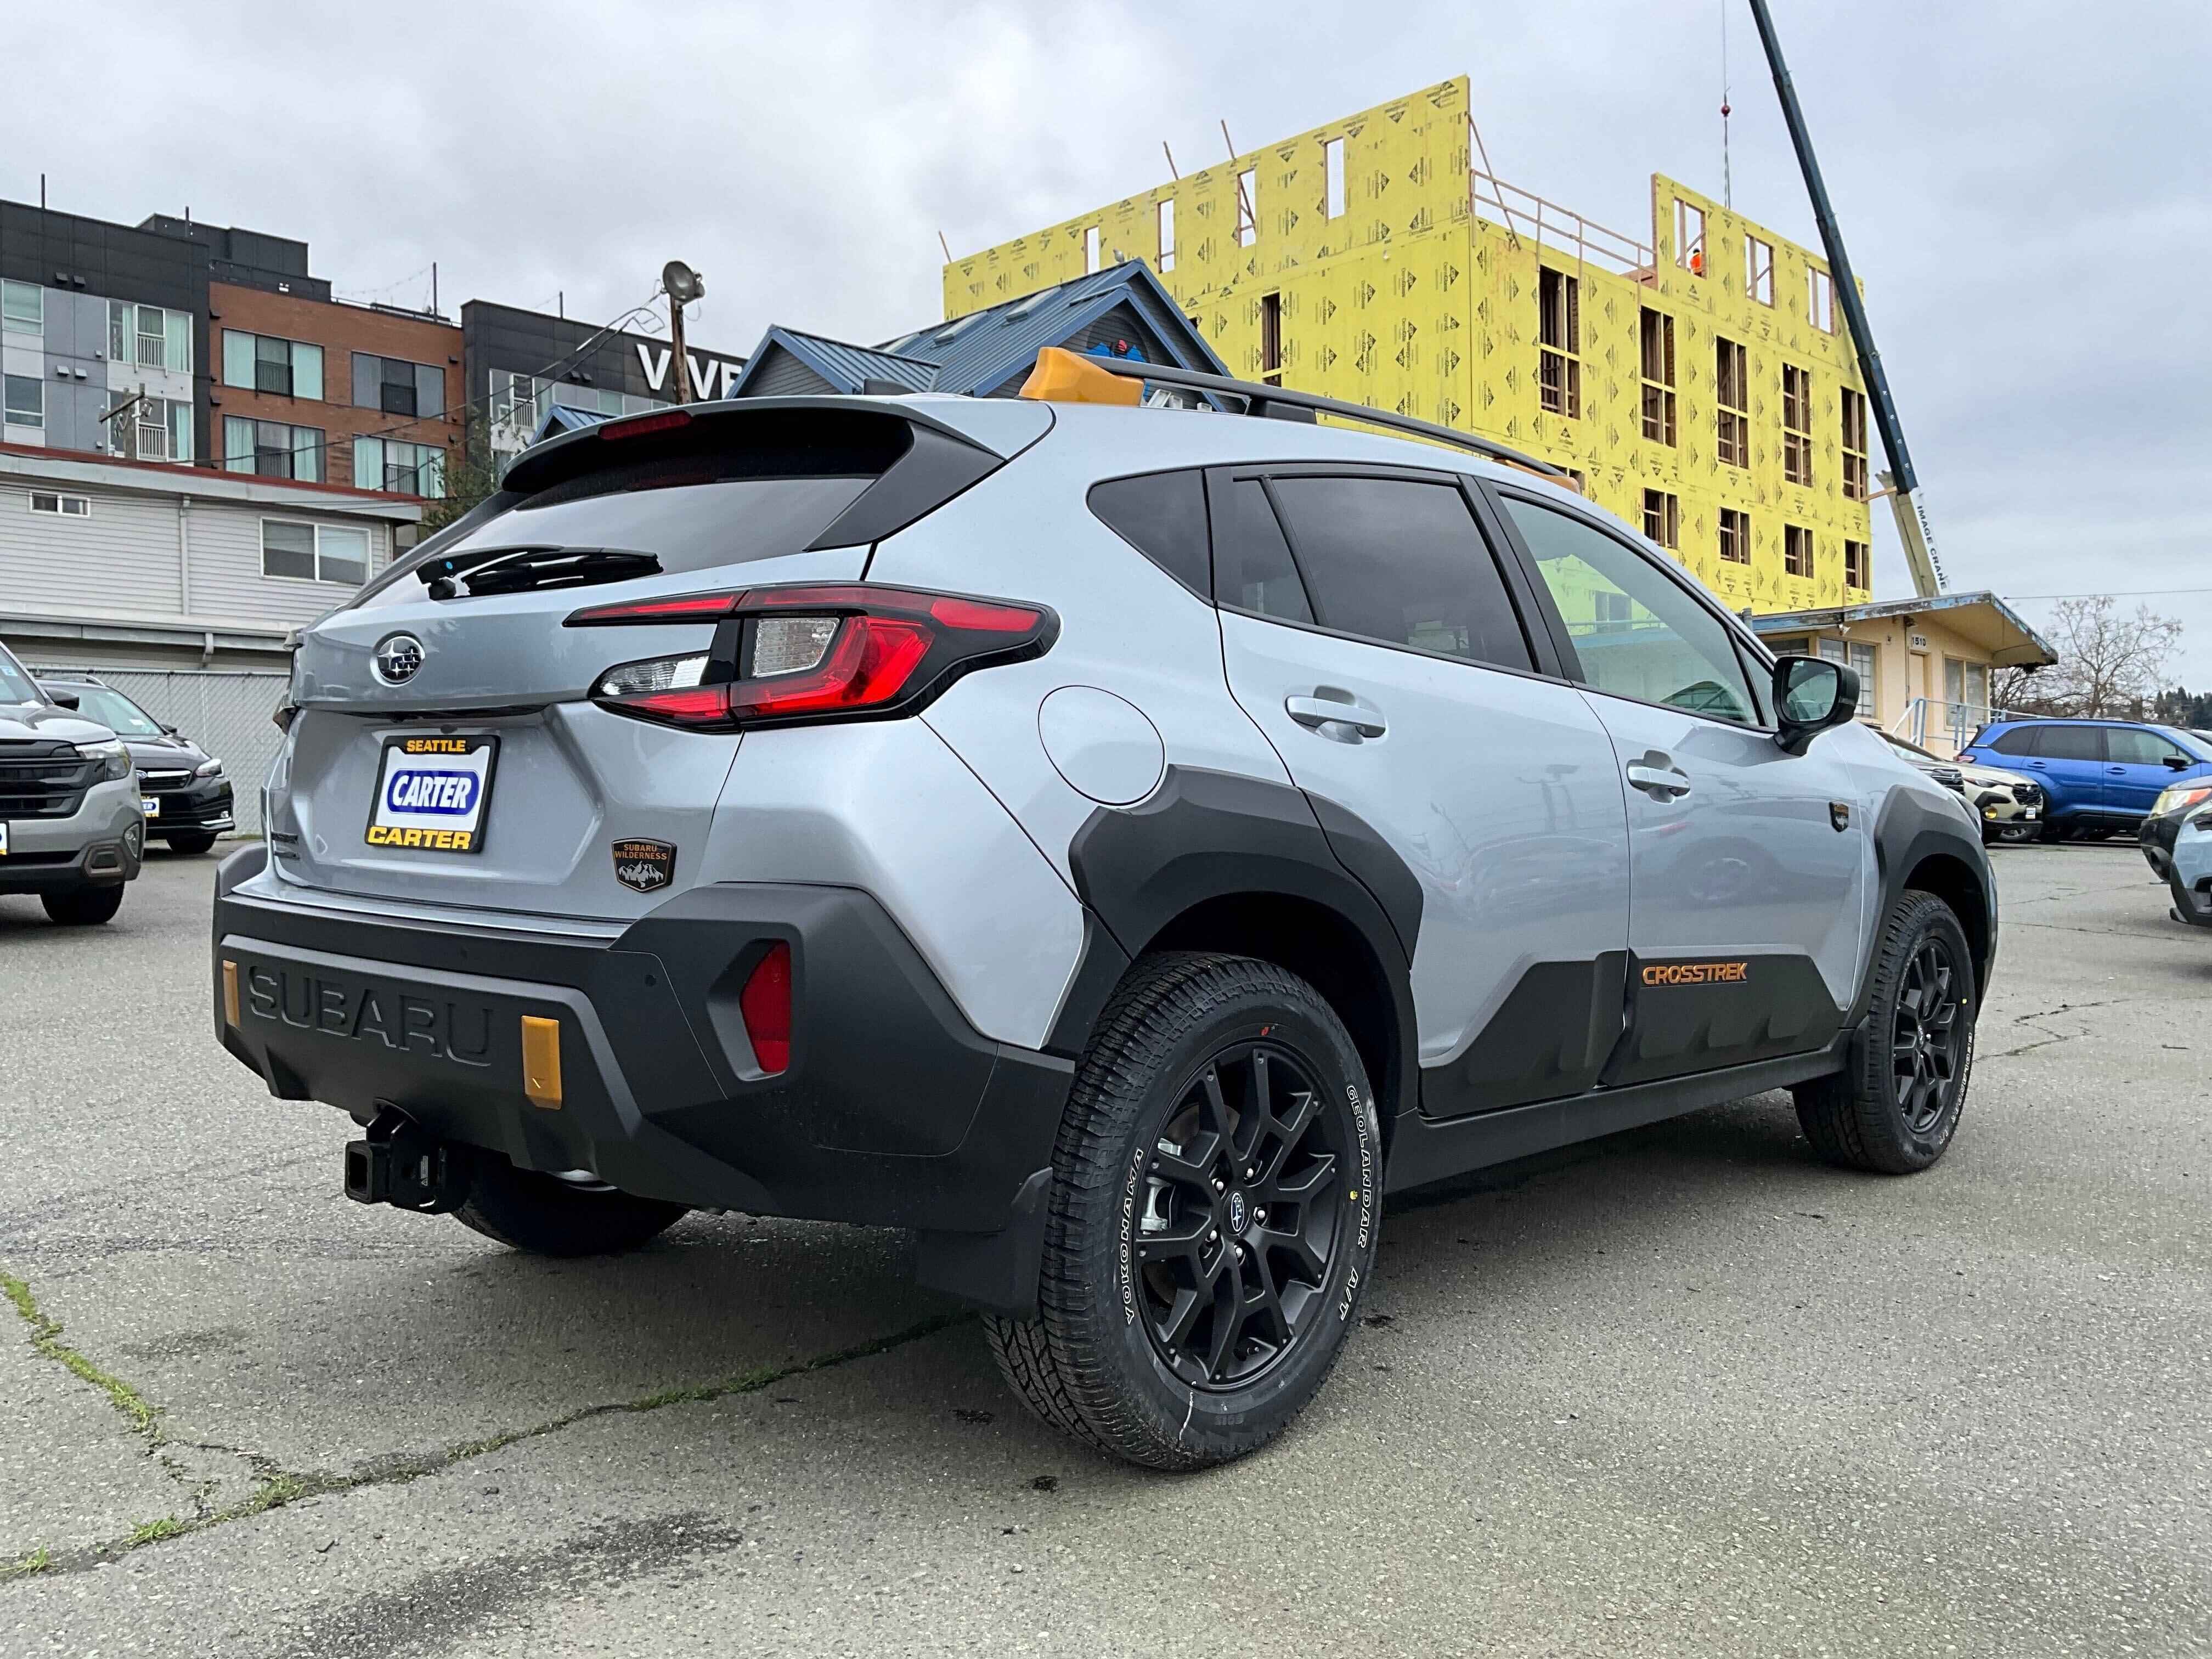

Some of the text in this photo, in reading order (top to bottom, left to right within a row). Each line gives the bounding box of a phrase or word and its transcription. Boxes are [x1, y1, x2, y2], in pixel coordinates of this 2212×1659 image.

[636, 343, 742, 400] VVE
[1917, 505, 1947, 590] IMAGE CRANE
[1912, 636, 1926, 646] 1510
[407, 740, 466, 752] SEATTLE
[392, 775, 472, 809] CARTER
[368, 826, 472, 850] CARTER
[624, 844, 657, 852] SUBARU
[614, 850, 668, 860] WILDERNESS
[1643, 962, 1748, 985] CROSSTREK
[249, 966, 493, 1066] SUBARU
[1339, 1085, 1372, 1321] GEOLANDAR A/T
[1120, 1148, 1143, 1325] YOKOHAMA
